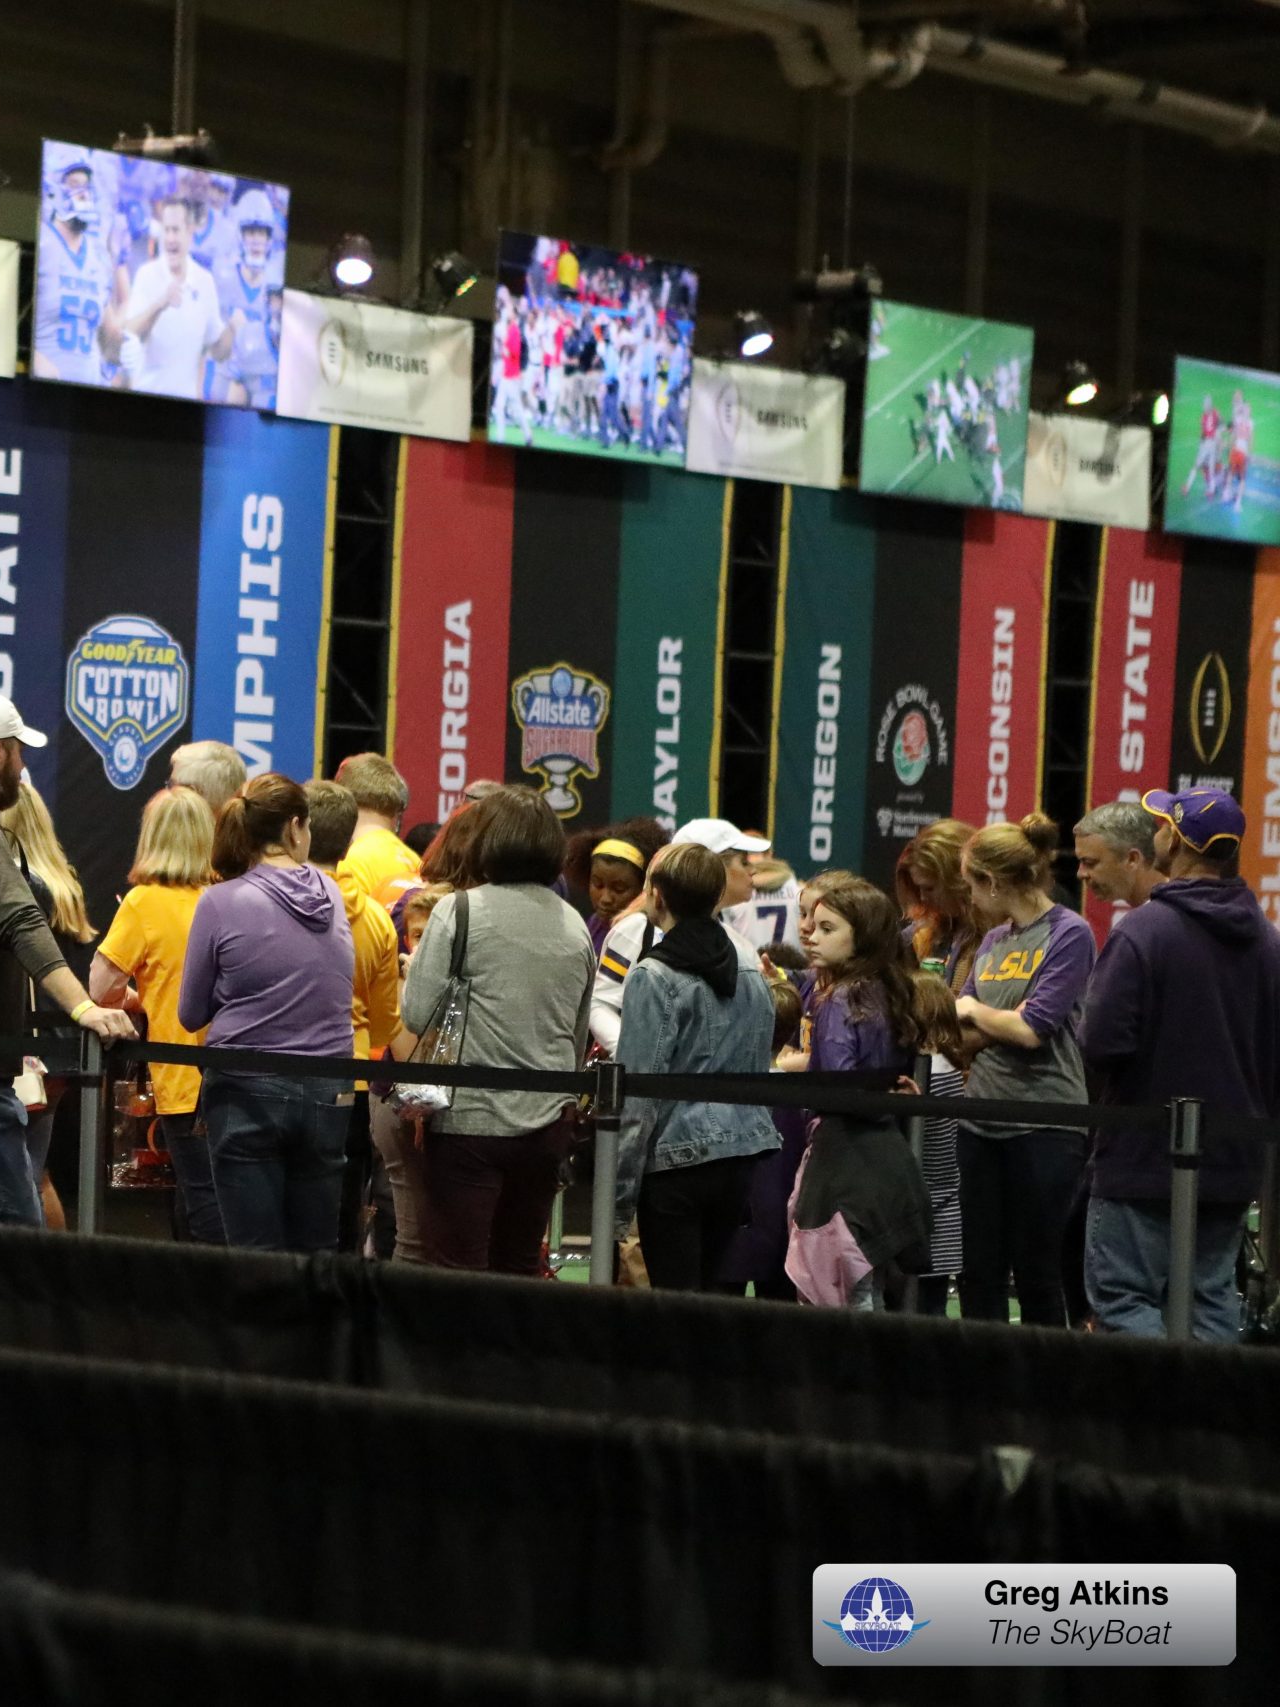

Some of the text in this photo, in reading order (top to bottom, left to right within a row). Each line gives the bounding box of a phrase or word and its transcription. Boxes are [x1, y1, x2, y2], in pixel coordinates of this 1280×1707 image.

[365, 351, 429, 375] SAMSUNG
[78, 665, 178, 719] COTTON
[1118, 578, 1155, 773] STATE
[96, 696, 160, 731] BOWL
[527, 696, 591, 726] Allstate
[896, 684, 930, 710] BOWL
[809, 643, 843, 862] OREGON
[756, 904, 787, 945] 7
[978, 949, 1045, 981] LSU
